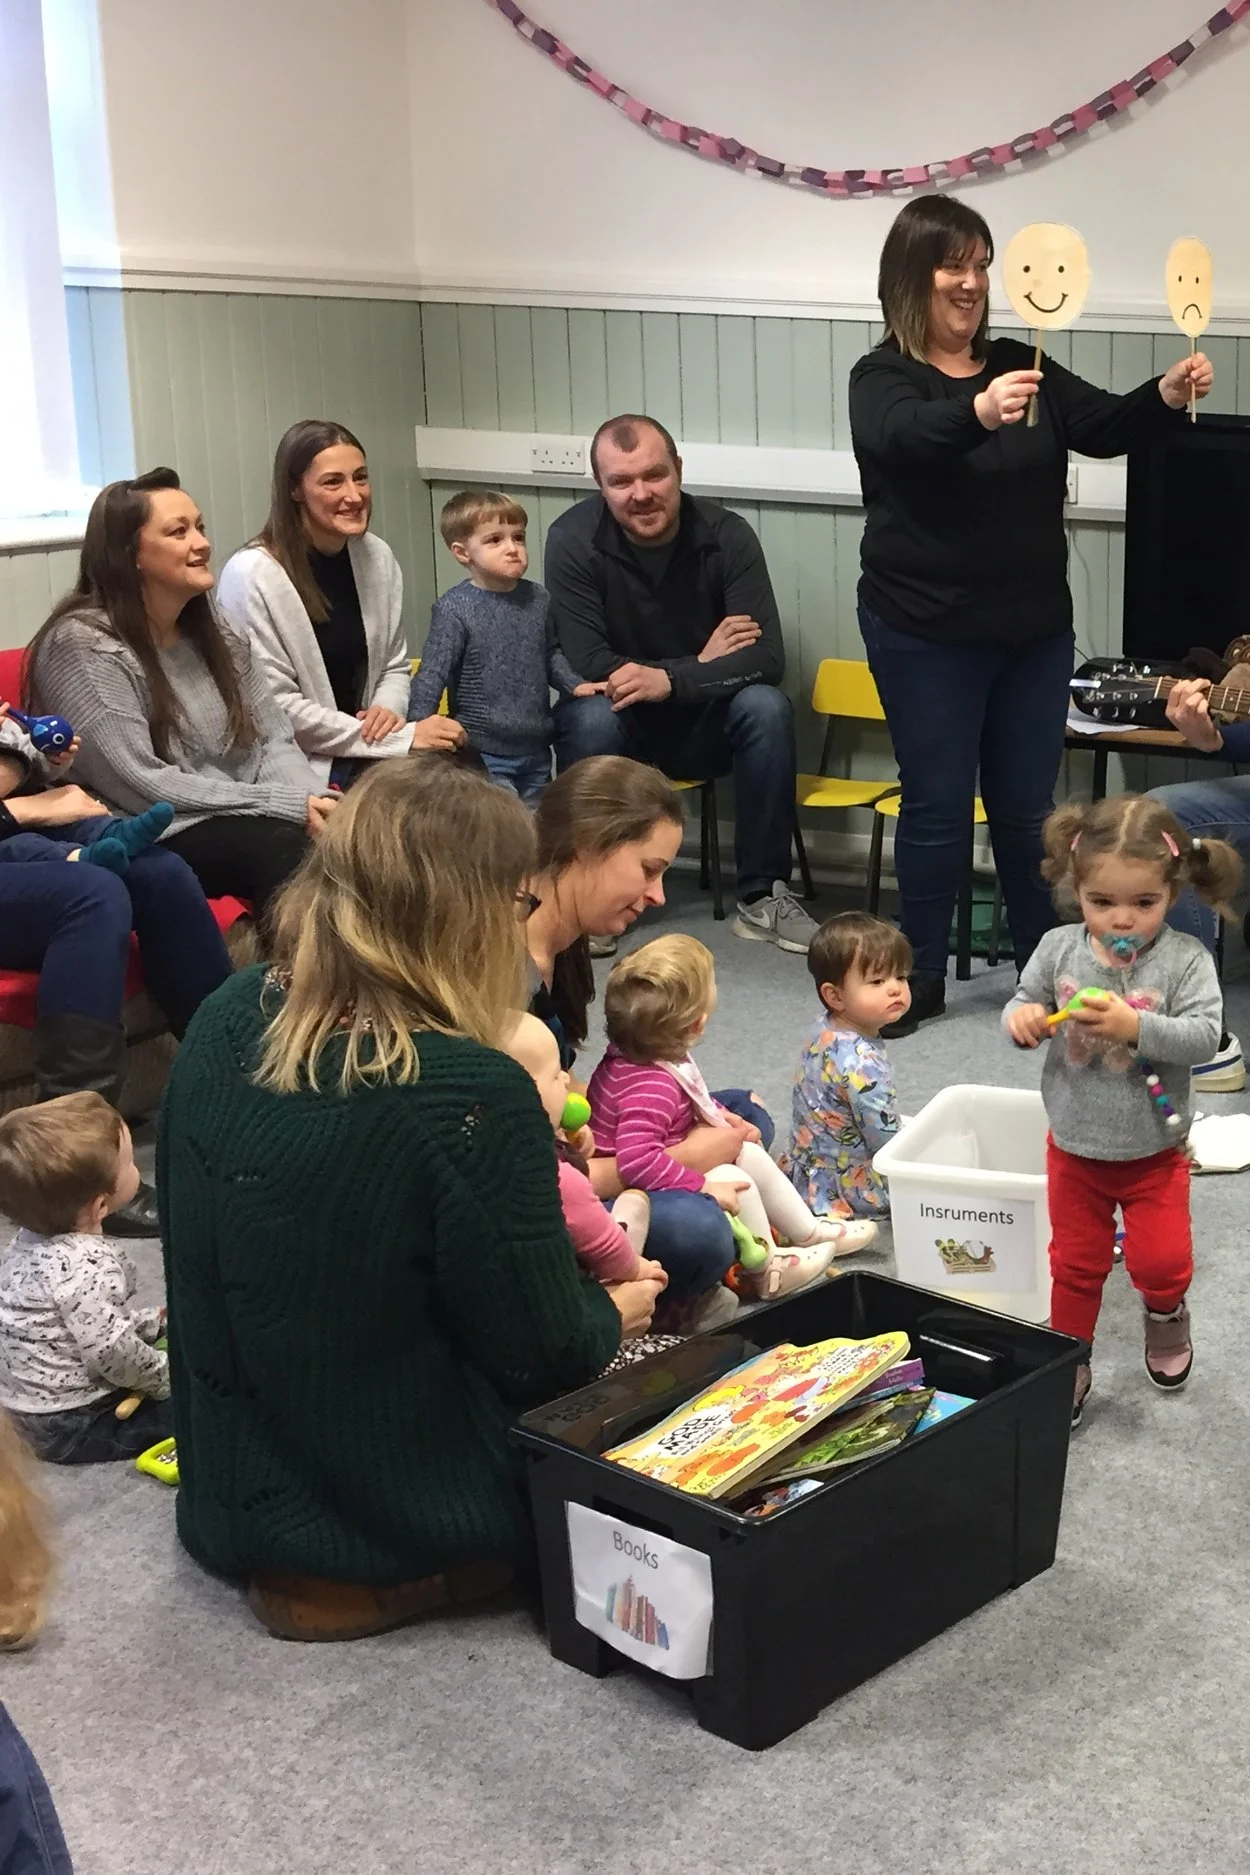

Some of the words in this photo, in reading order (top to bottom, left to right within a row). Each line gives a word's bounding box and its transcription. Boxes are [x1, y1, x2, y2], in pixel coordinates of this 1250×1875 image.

[920, 1203, 1014, 1224] Insruments
[658, 1418, 702, 1445] GOD
[664, 1414, 721, 1451] MADE
[613, 1531, 659, 1569] Books
